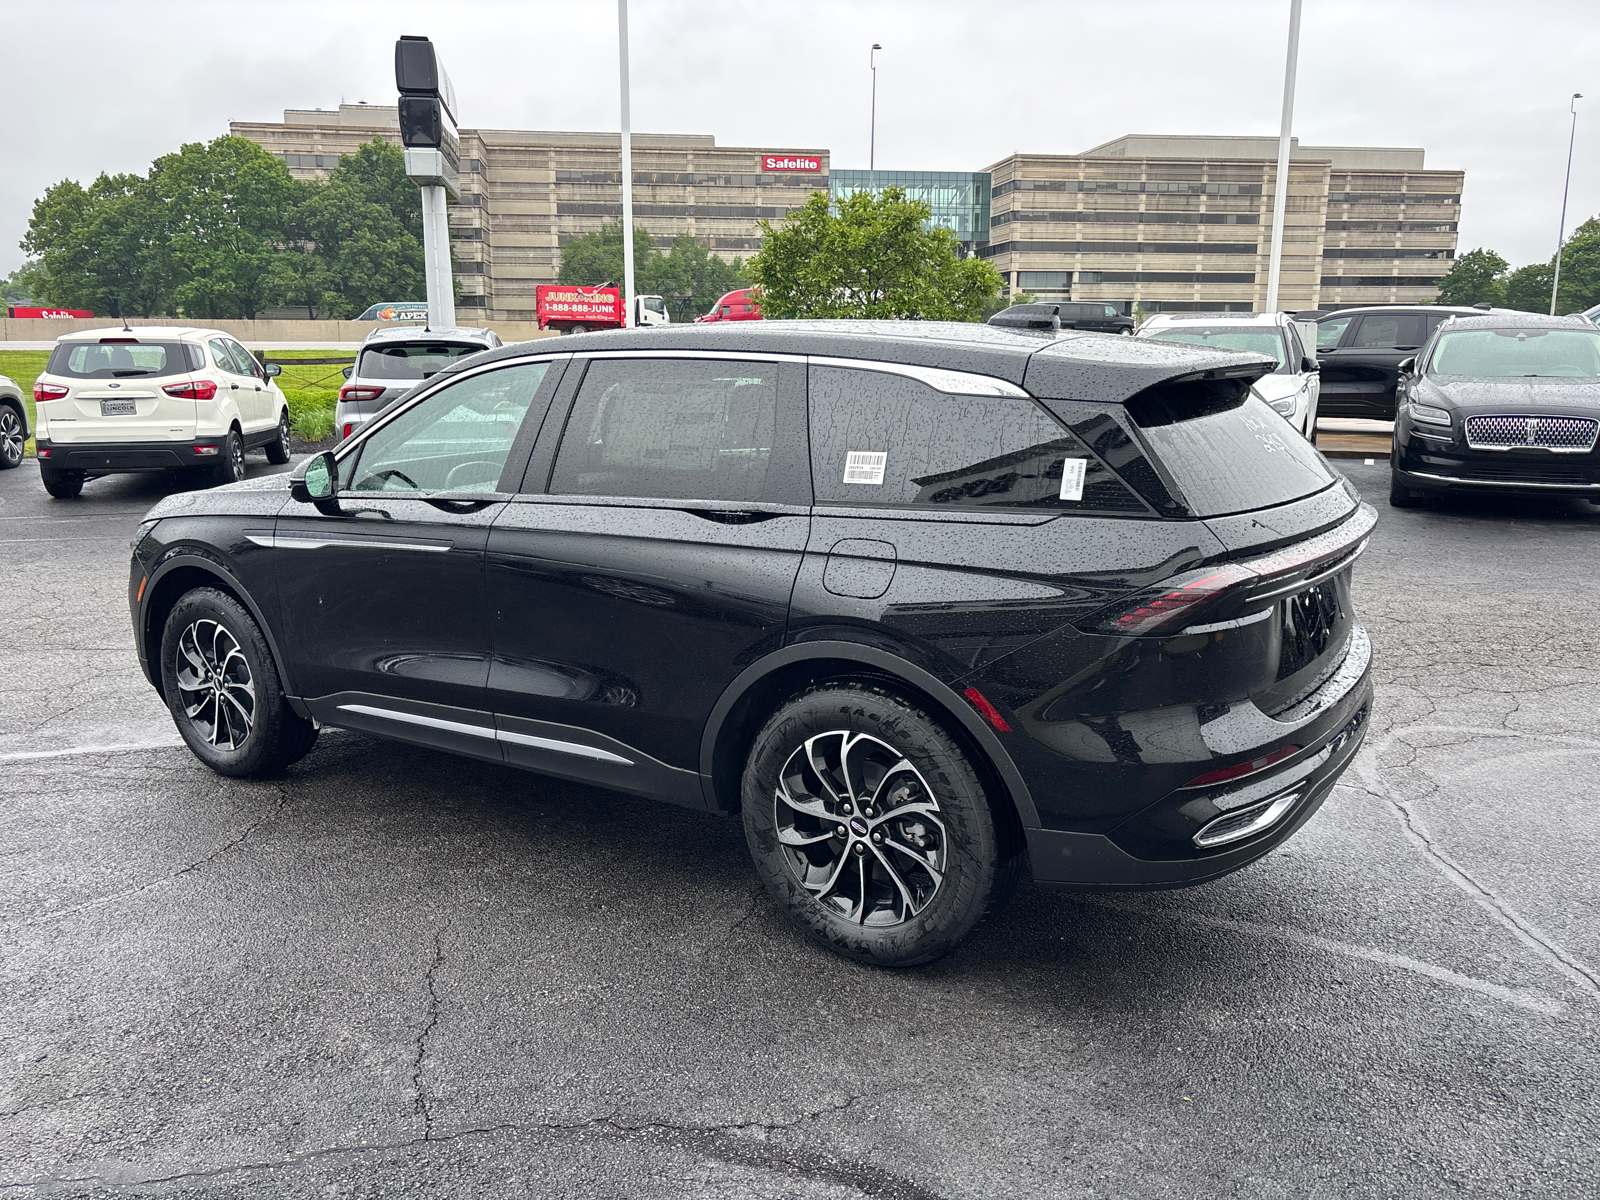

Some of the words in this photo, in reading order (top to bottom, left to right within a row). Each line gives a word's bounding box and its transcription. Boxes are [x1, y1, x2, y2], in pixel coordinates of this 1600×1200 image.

[766, 158, 818, 169] Safelite
[545, 292, 578, 302] JUNK
[584, 293, 615, 303] KING
[545, 303, 615, 313] 1-888-888-JUNK
